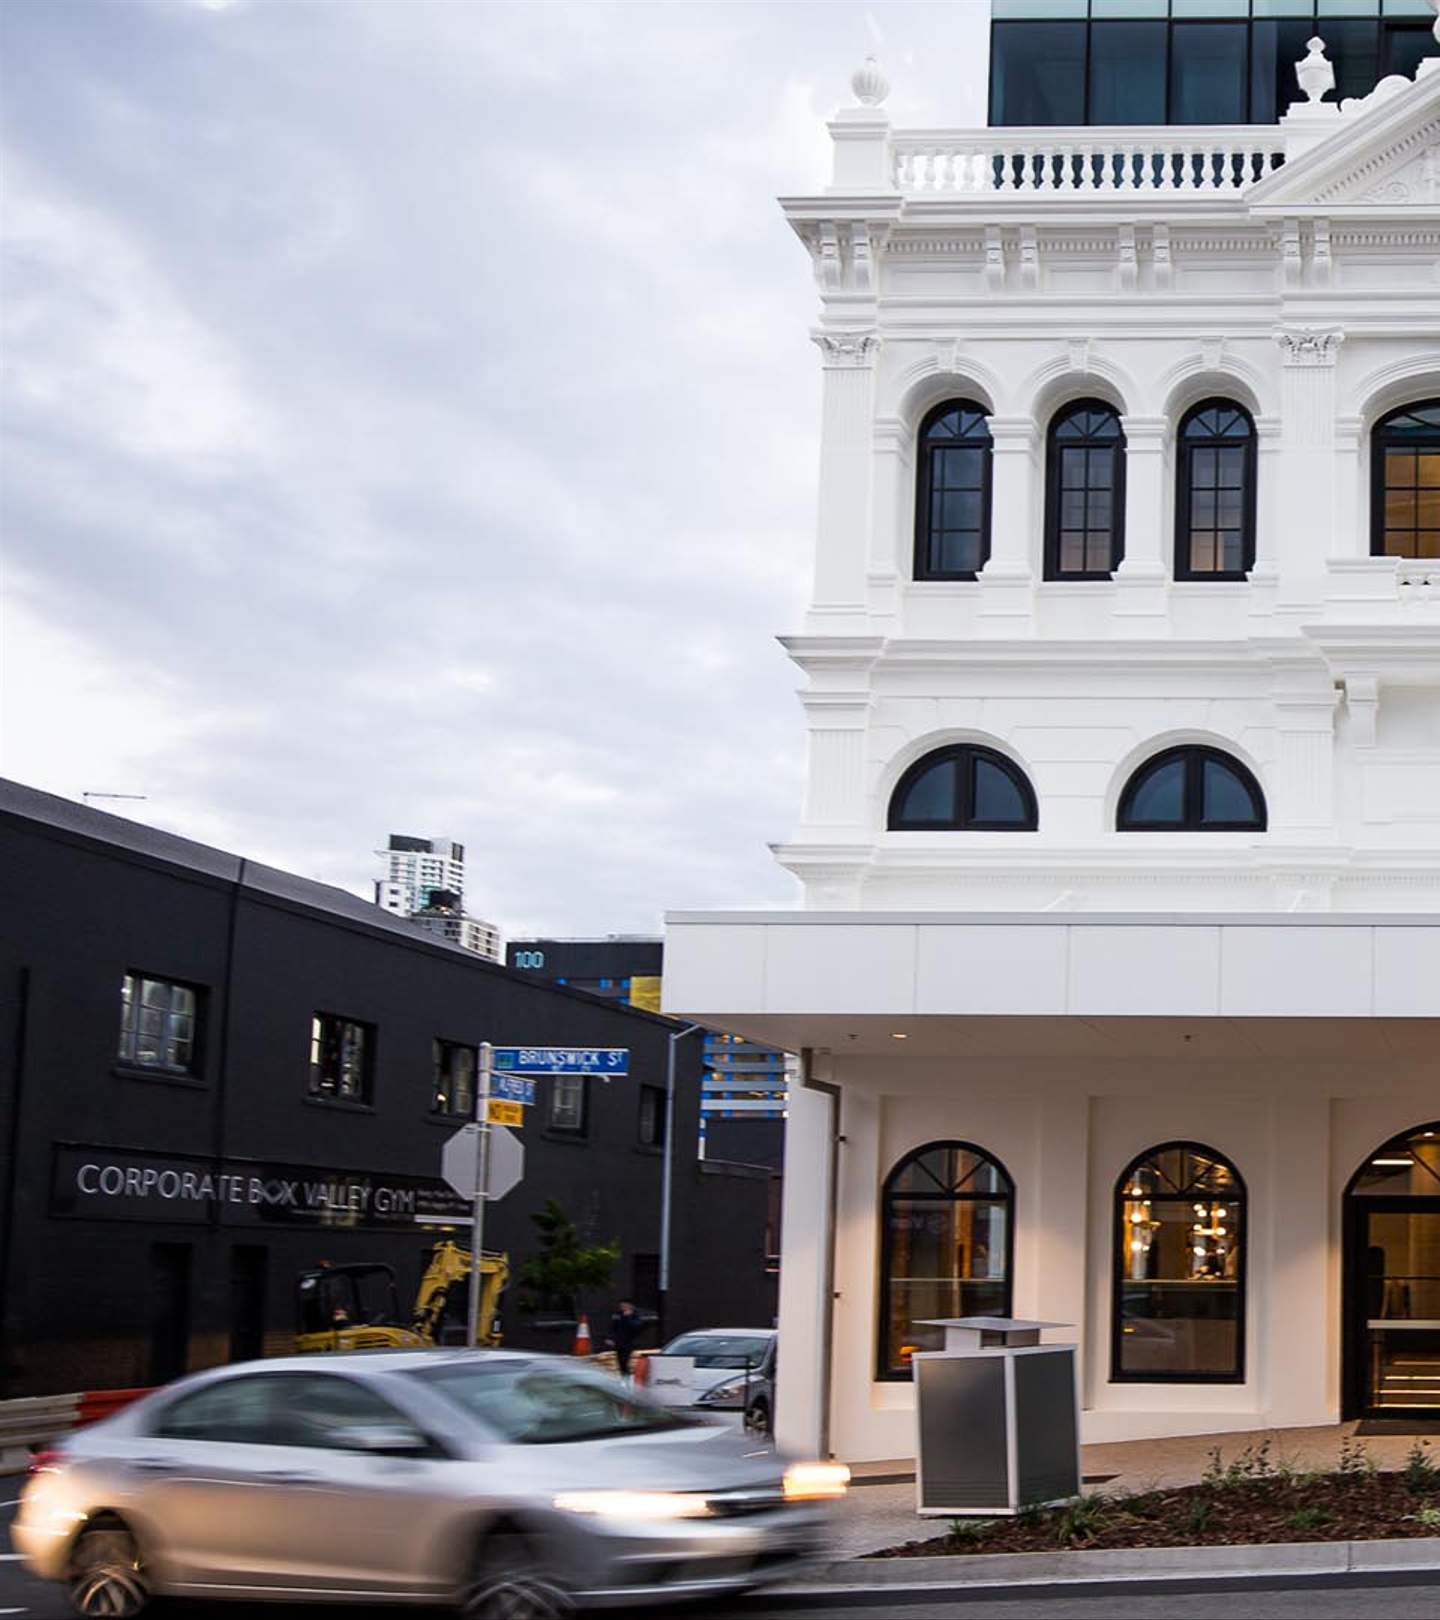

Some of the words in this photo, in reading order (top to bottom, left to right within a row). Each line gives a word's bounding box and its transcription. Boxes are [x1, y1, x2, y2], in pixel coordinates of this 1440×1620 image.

[514, 951, 545, 968] 100
[518, 1050, 600, 1066] BRUNSWICK
[76, 1163, 244, 1203] CORPORATE
[249, 1177, 298, 1206] BOX
[304, 1180, 372, 1211] VALLEY
[374, 1186, 415, 1215] GYM
